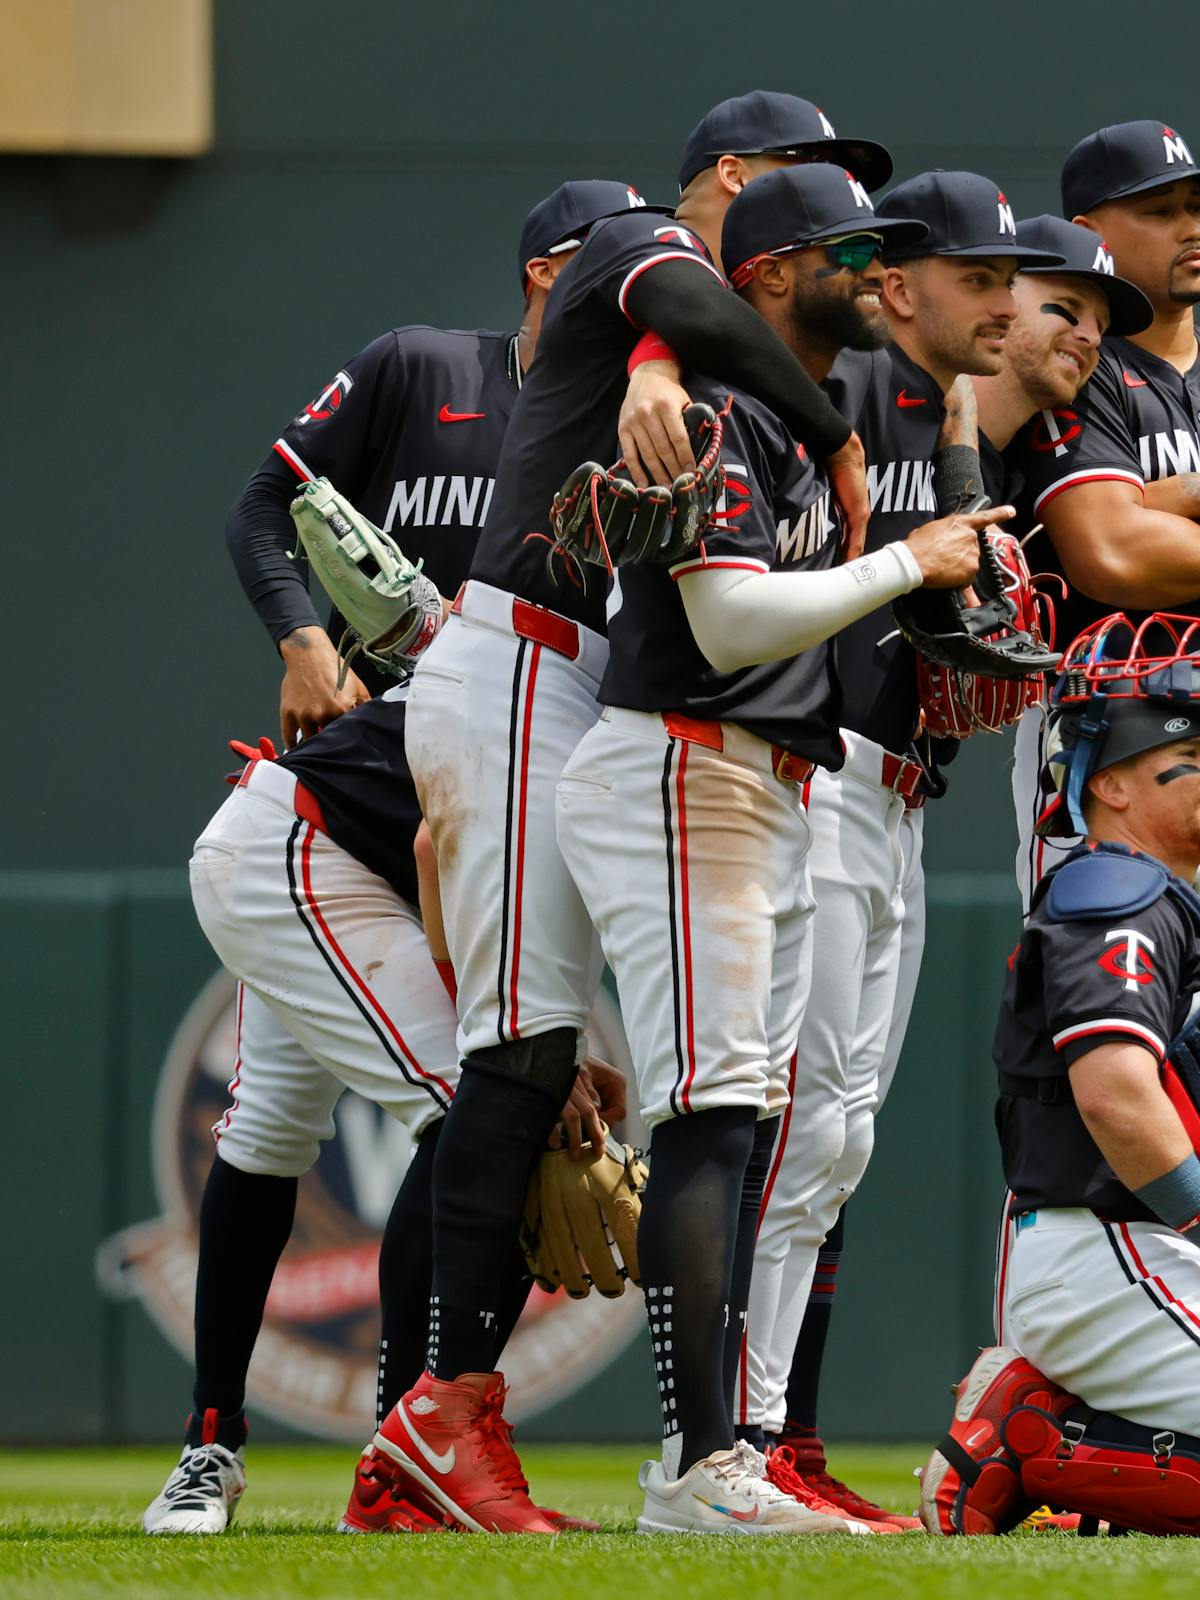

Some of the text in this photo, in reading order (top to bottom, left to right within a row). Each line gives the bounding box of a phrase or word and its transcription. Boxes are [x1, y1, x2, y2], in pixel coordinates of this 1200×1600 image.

[1163, 136, 1194, 164] M
[848, 179, 874, 208] M
[998, 203, 1017, 236] M
[1091, 246, 1114, 276] M
